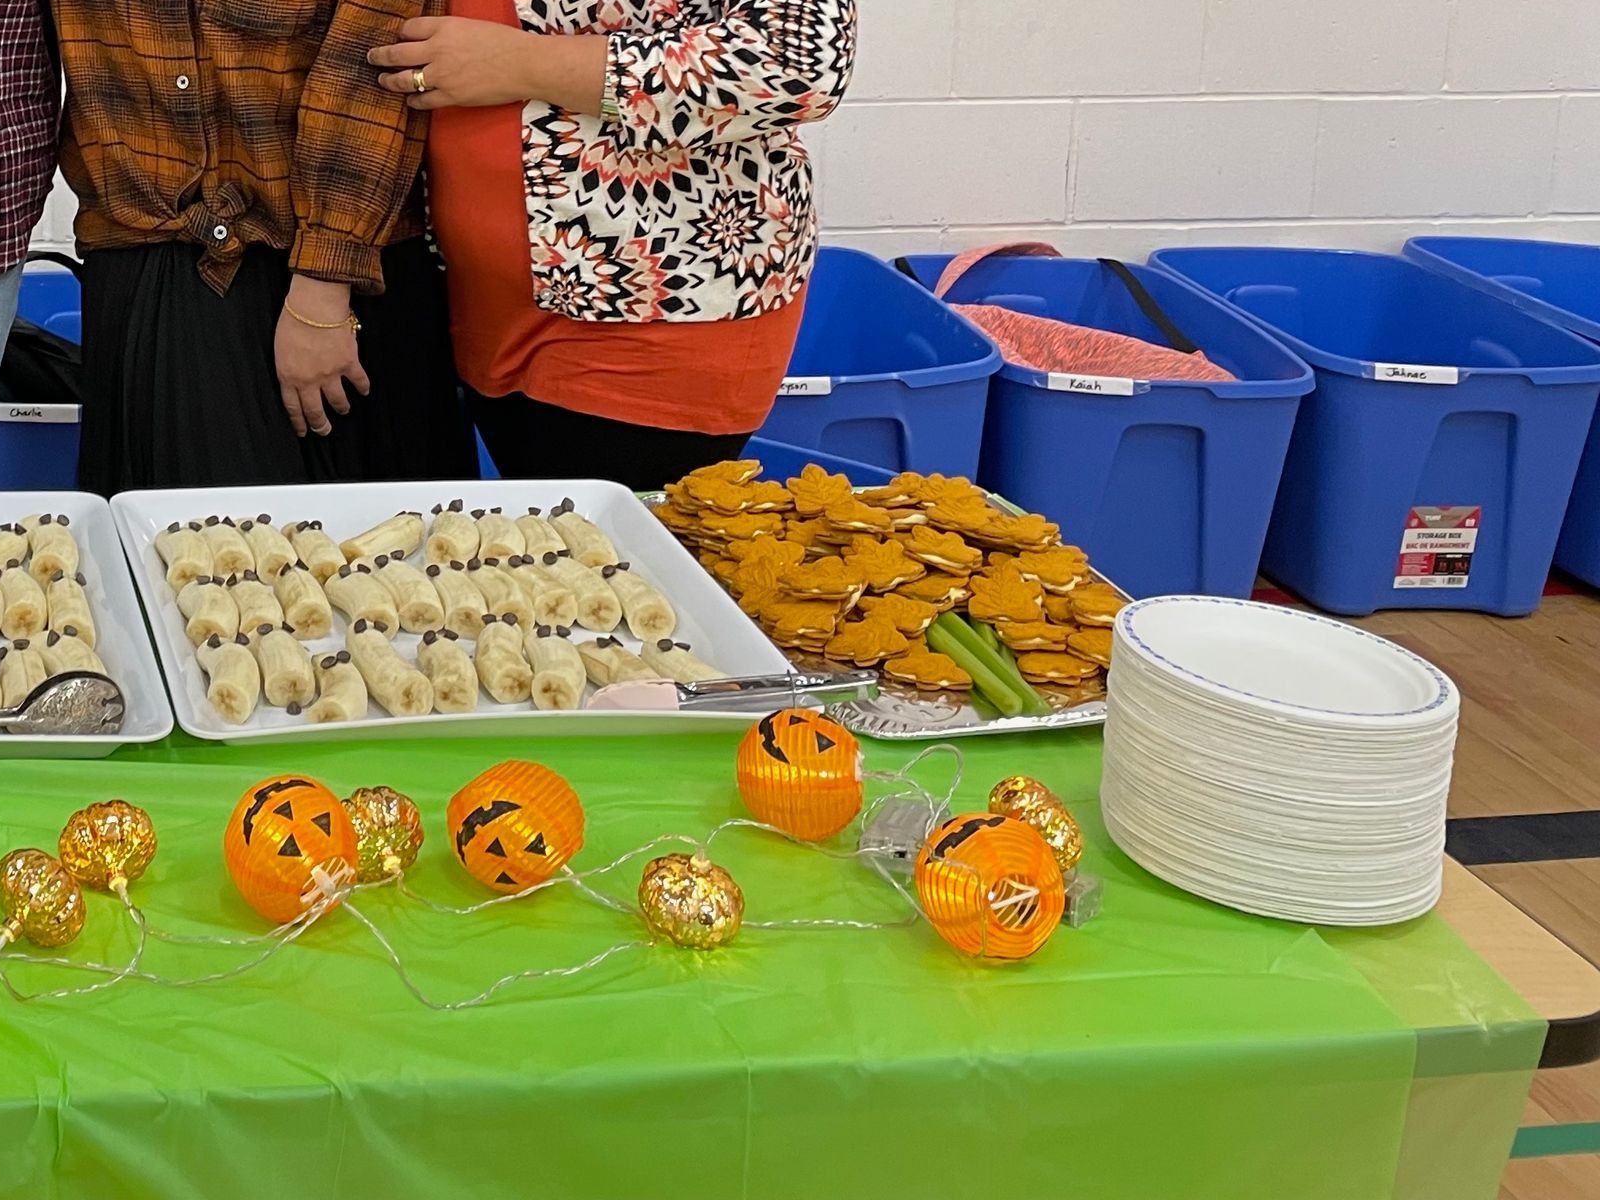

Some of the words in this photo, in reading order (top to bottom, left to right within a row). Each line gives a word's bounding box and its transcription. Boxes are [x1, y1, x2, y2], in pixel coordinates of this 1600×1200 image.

[1069, 378, 1102, 391] Kaiah
[9, 406, 43, 417] Charlie
[1417, 532, 1447, 540] STORAGE
